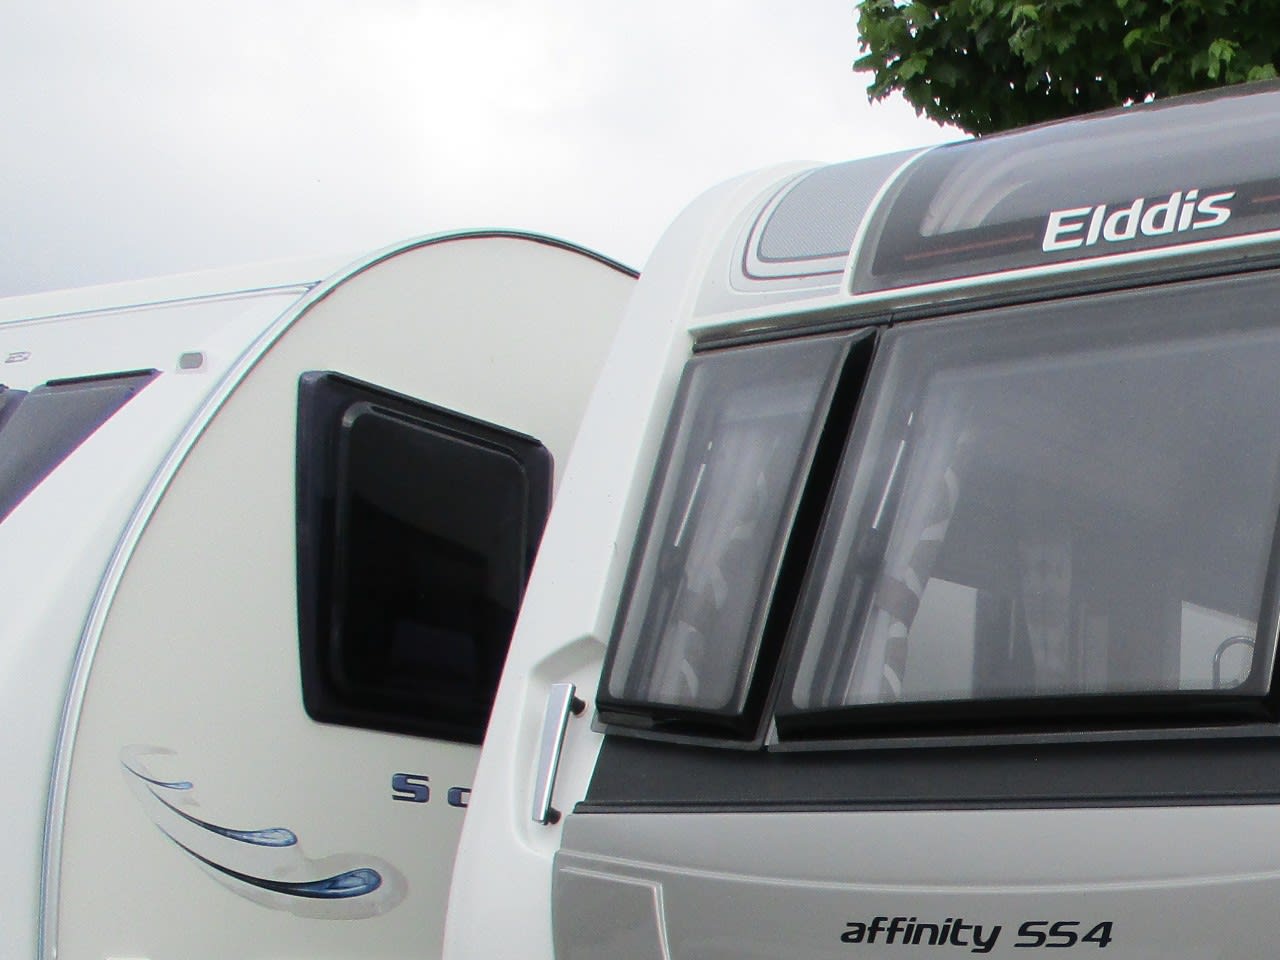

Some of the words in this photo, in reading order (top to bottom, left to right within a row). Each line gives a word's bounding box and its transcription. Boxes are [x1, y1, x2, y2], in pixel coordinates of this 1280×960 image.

[1042, 188, 1236, 253] Elddis
[840, 916, 1002, 953] affinity
[1014, 921, 1113, 948] SS4
